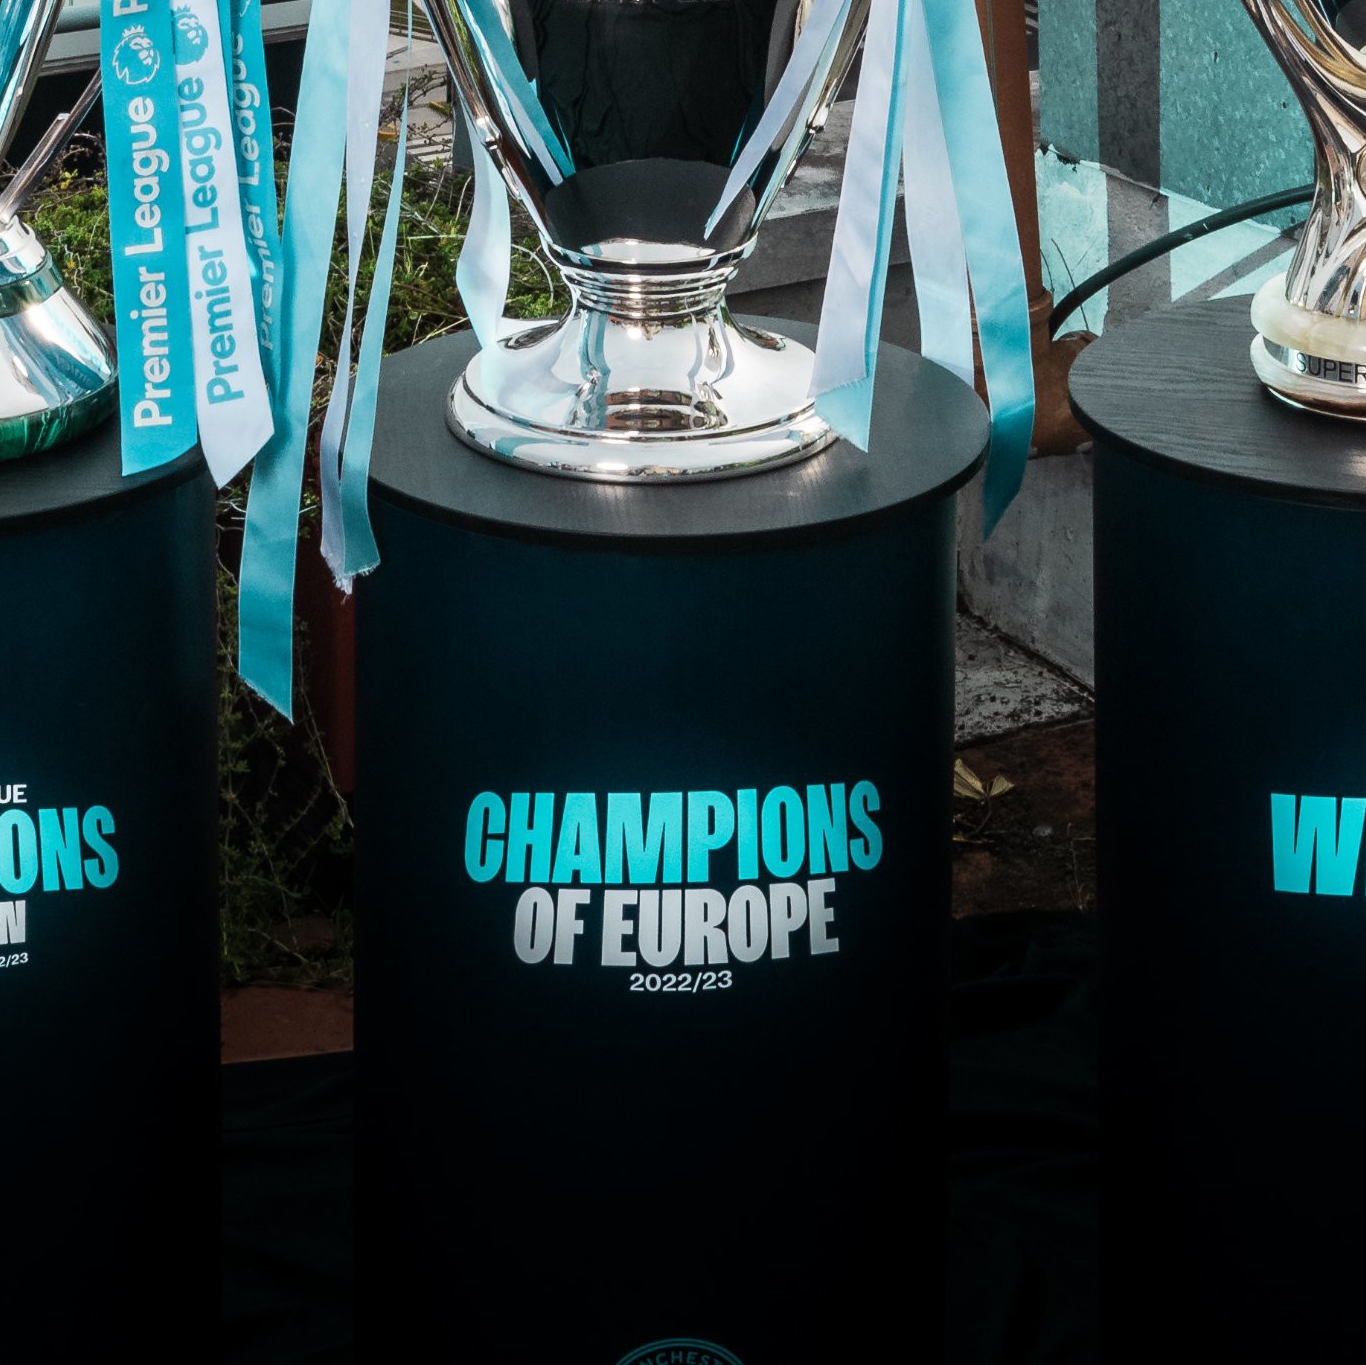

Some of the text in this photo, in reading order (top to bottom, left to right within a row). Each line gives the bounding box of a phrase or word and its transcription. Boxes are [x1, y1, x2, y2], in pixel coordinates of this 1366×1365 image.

[123, 95, 173, 429] Premier League
[177, 75, 245, 405] Premier League
[232, 33, 275, 352] Premier League
[464, 780, 883, 884] CHAMPIONS
[512, 878, 840, 967] OF EUROPE
[629, 970, 733, 994] 2022/23
